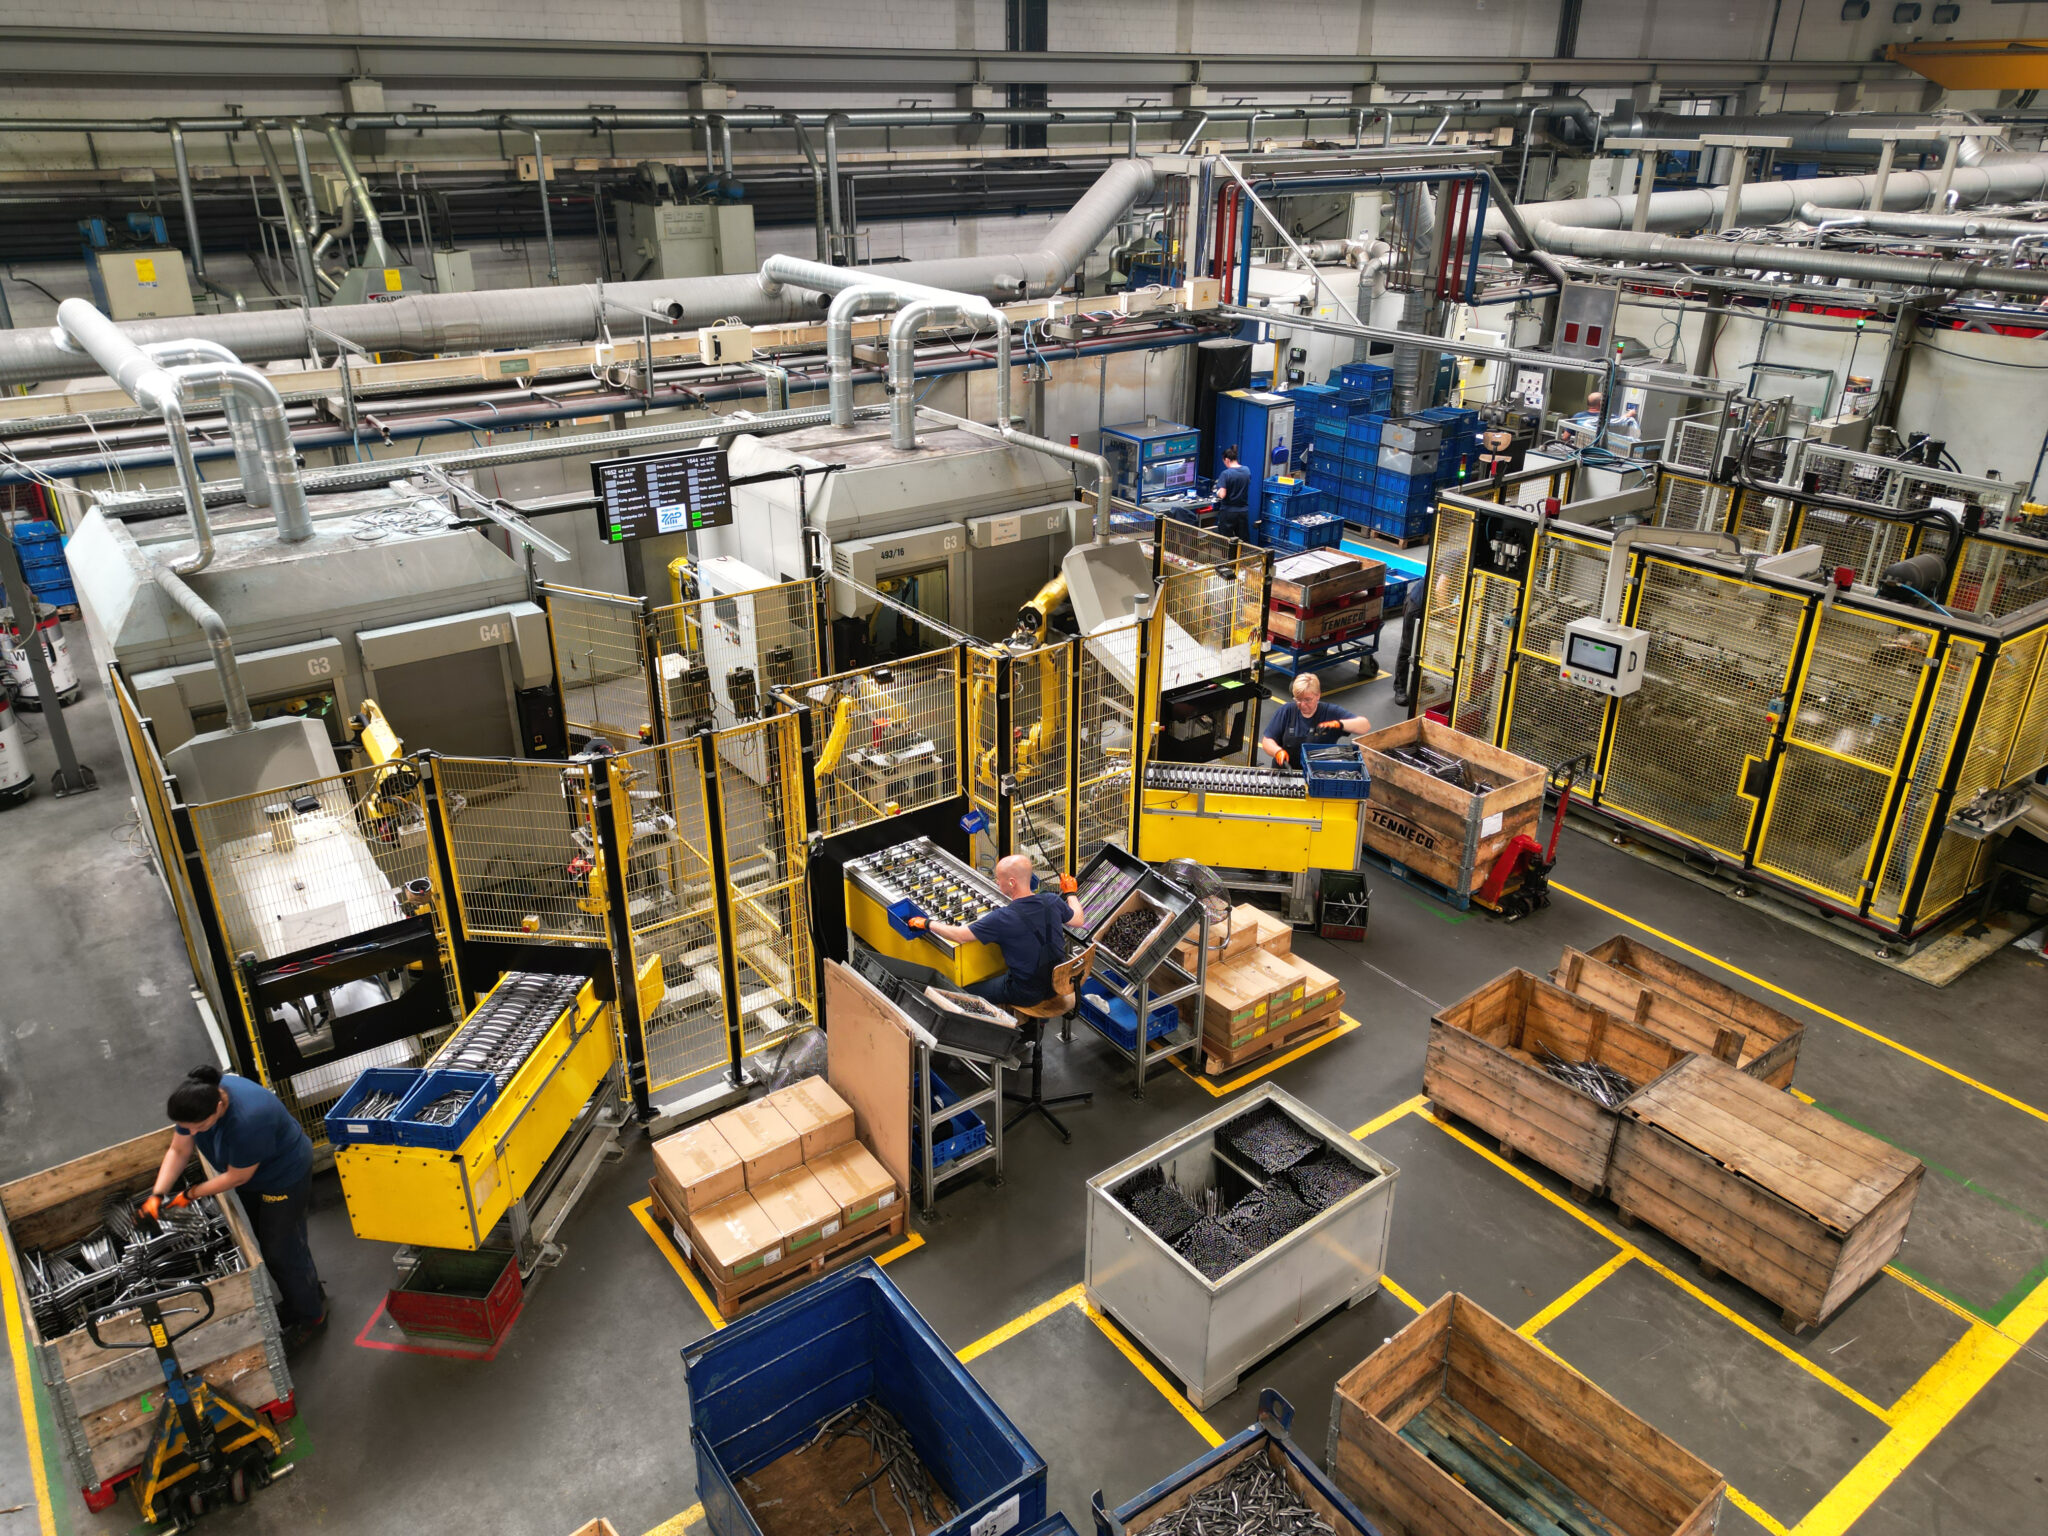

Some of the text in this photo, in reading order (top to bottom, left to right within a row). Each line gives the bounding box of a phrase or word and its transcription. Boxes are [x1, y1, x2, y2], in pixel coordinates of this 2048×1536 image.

[1047, 516, 1060, 530] G4
[943, 535, 958, 550] G3
[1323, 610, 1365, 631] TENNECO
[479, 624, 500, 642] G4
[307, 656, 331, 676] G3
[1371, 810, 1435, 850] TENNECO
